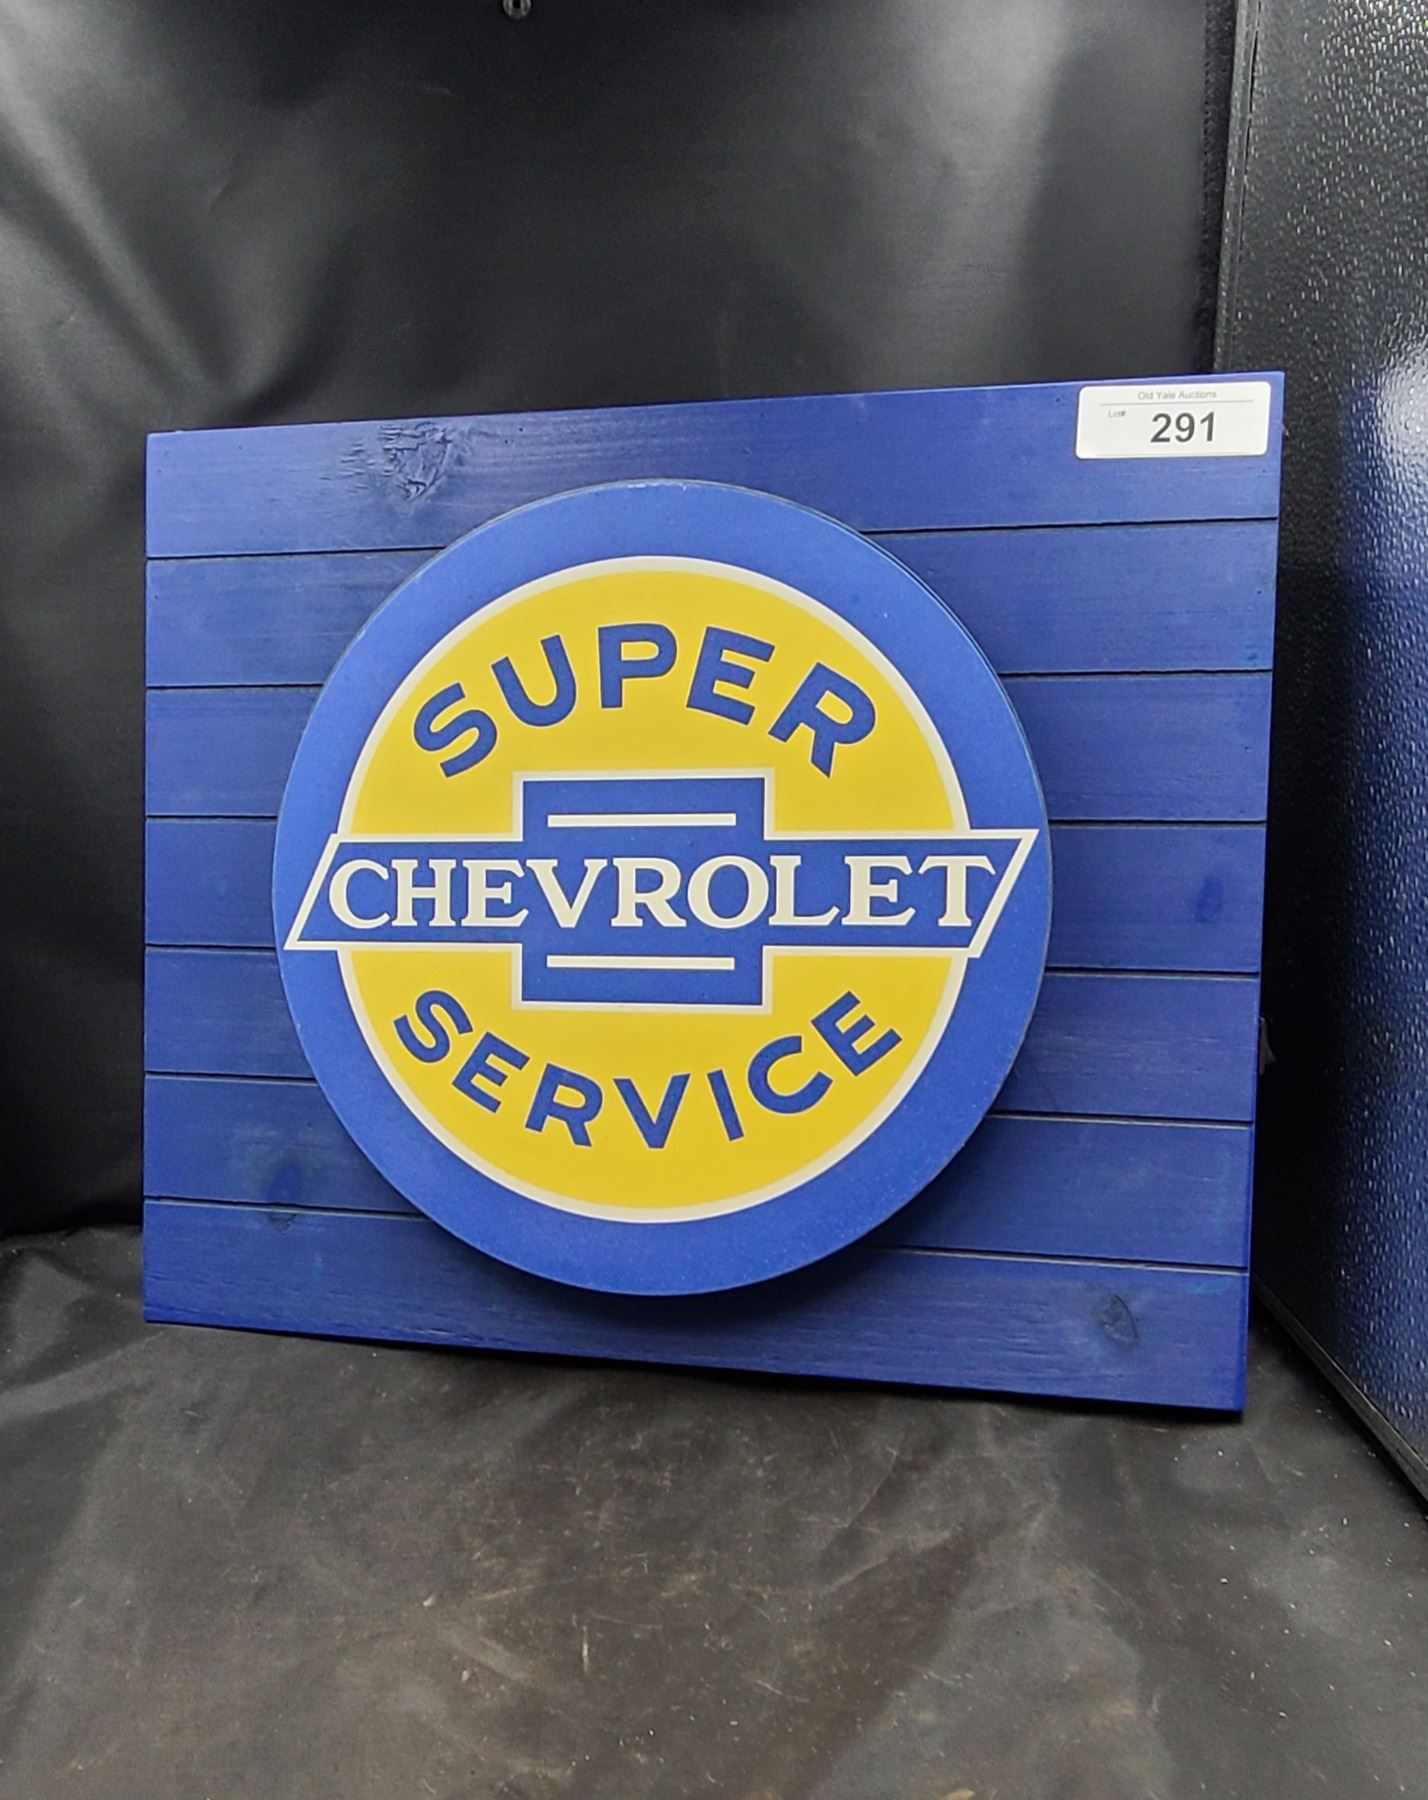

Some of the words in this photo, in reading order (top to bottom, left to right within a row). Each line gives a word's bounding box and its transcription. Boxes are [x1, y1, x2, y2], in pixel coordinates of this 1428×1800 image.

[1138, 391, 1153, 400] Old
[1156, 391, 1176, 400] Yale
[1178, 389, 1217, 399] Auctions
[1150, 411, 1215, 443] 291
[412, 622, 877, 778] SUPER
[327, 854, 997, 930] CHEVROLET
[393, 990, 903, 1150] SERVICE
